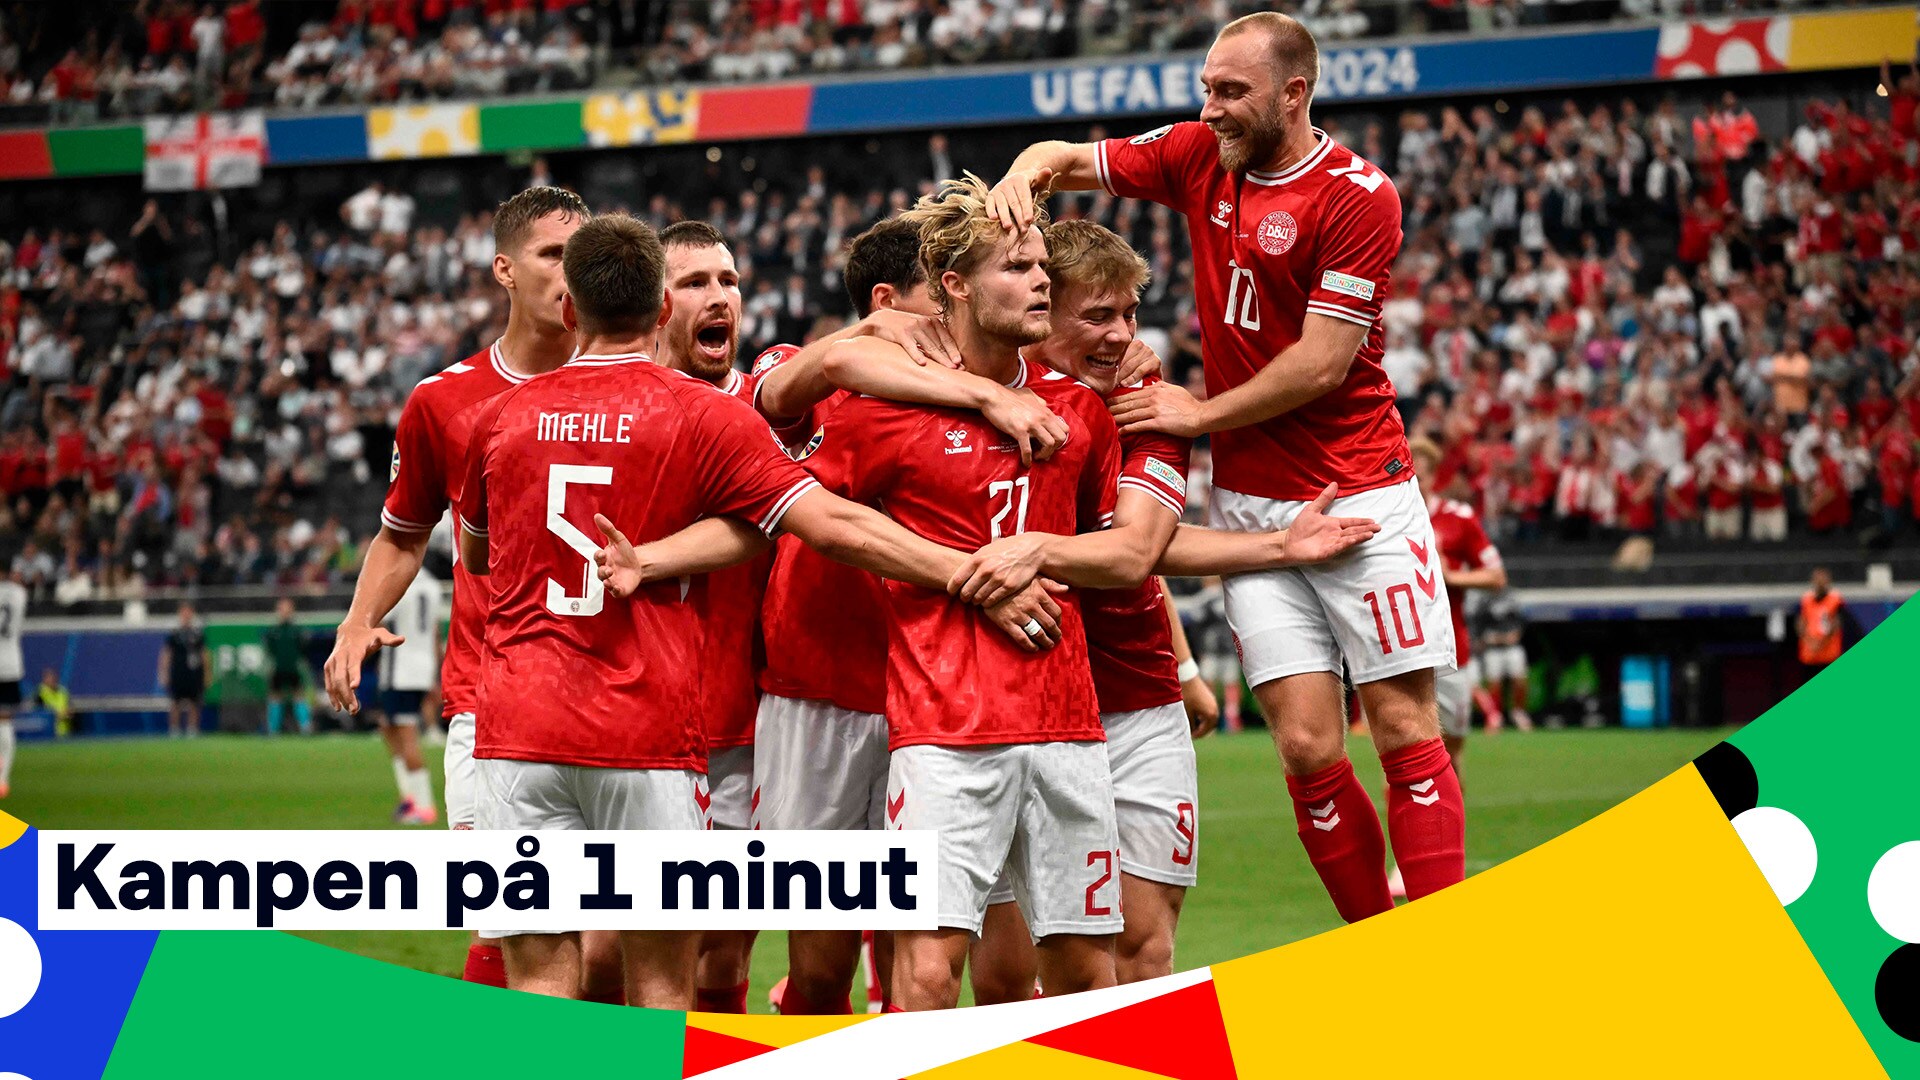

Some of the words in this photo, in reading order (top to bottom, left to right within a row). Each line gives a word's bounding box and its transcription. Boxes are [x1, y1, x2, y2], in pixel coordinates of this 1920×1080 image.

[1265, 224, 1290, 240] DBU
[1224, 259, 1261, 331] 10
[1323, 275, 1374, 295] FOUNDATION
[537, 412, 633, 443] MÆHLE
[546, 463, 614, 616] 5
[989, 475, 1029, 541] 21
[1363, 583, 1426, 655] 10
[1172, 802, 1195, 865] 9
